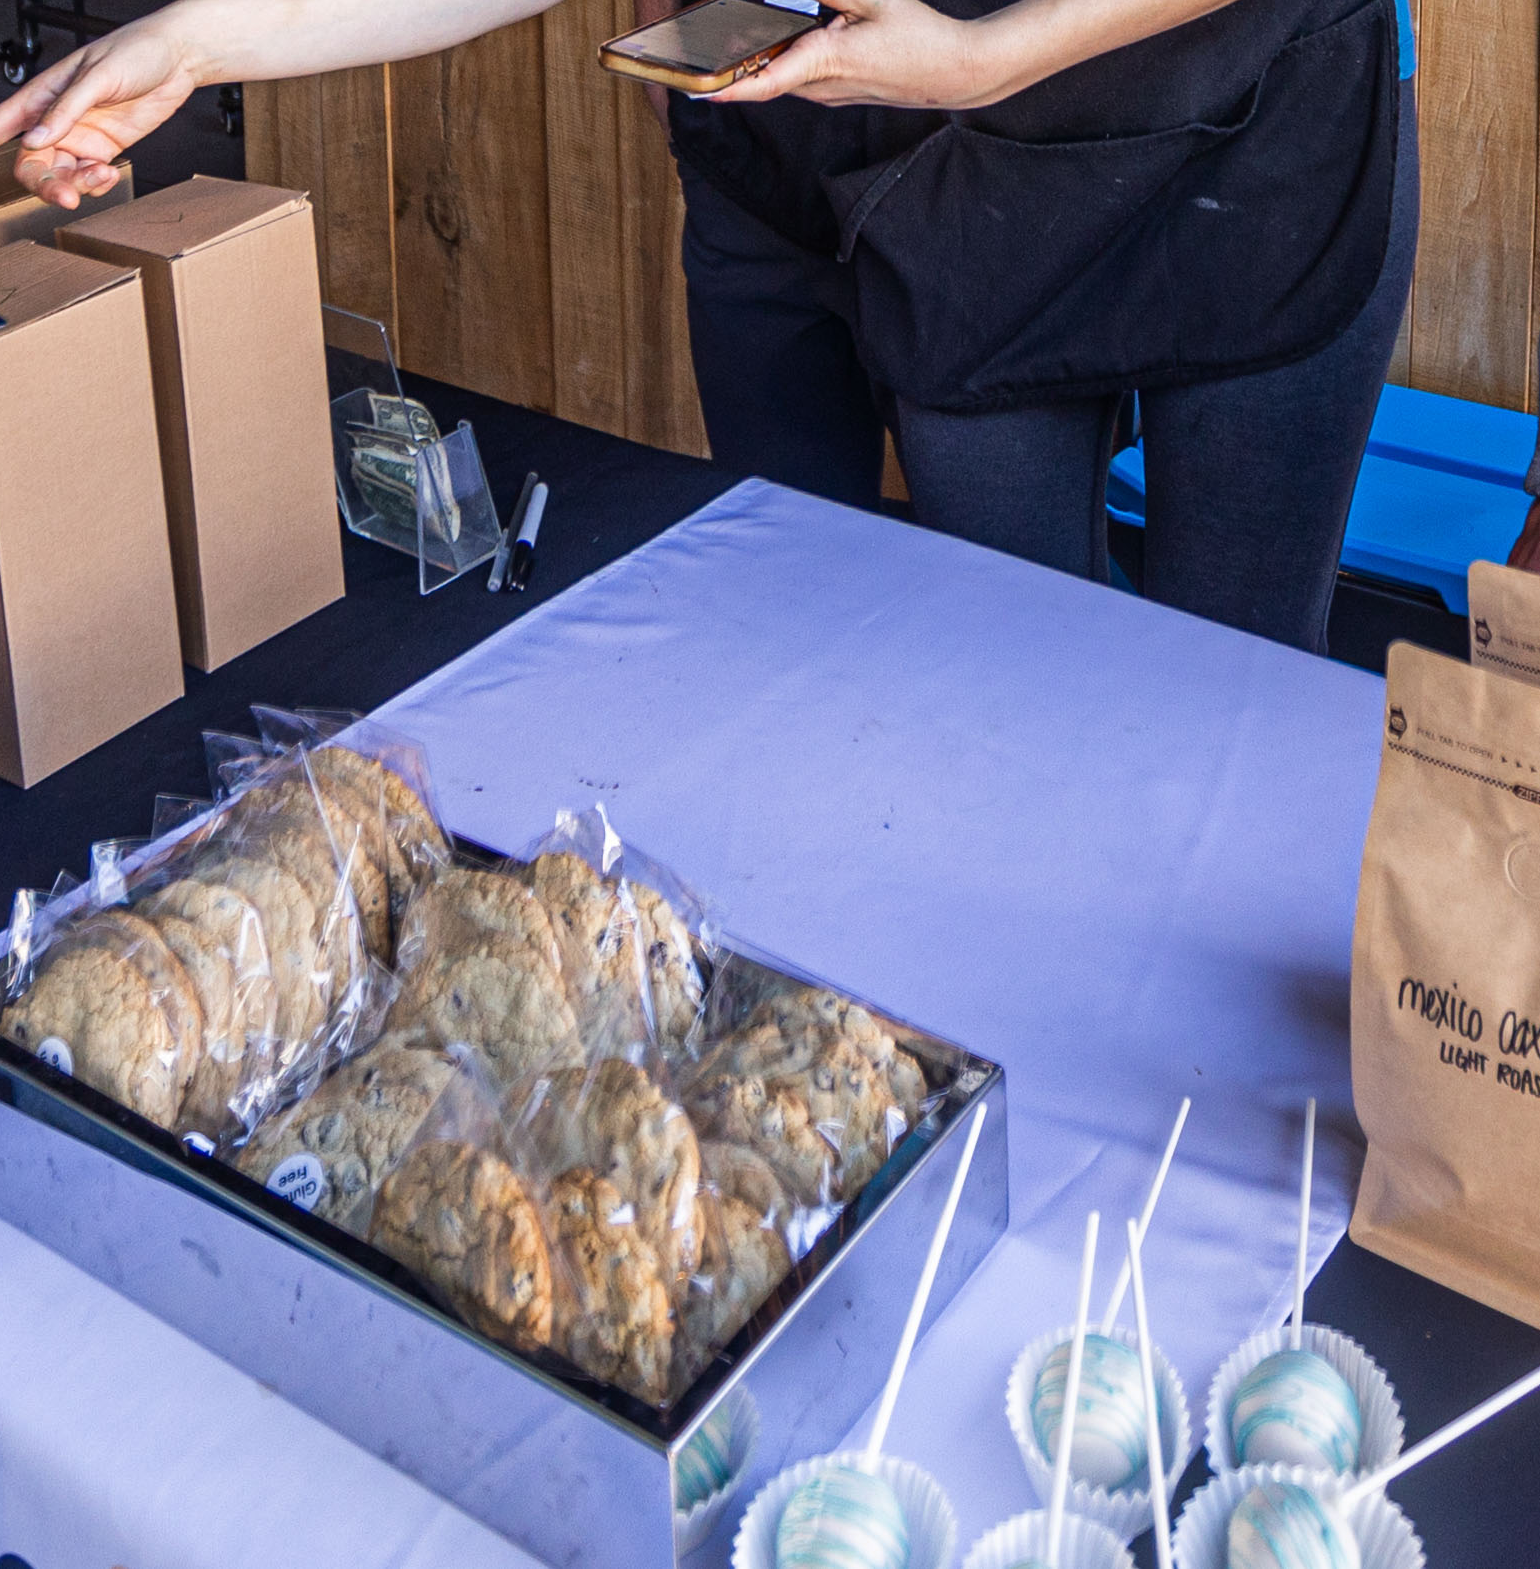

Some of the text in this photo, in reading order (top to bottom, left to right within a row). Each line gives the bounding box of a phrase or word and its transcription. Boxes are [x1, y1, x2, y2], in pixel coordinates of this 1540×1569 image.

[1457, 741, 1468, 751] TO
[1439, 1041, 1490, 1075] LIGHT
[278, 1166, 308, 1188] Free
[284, 1180, 317, 1202] Glut
